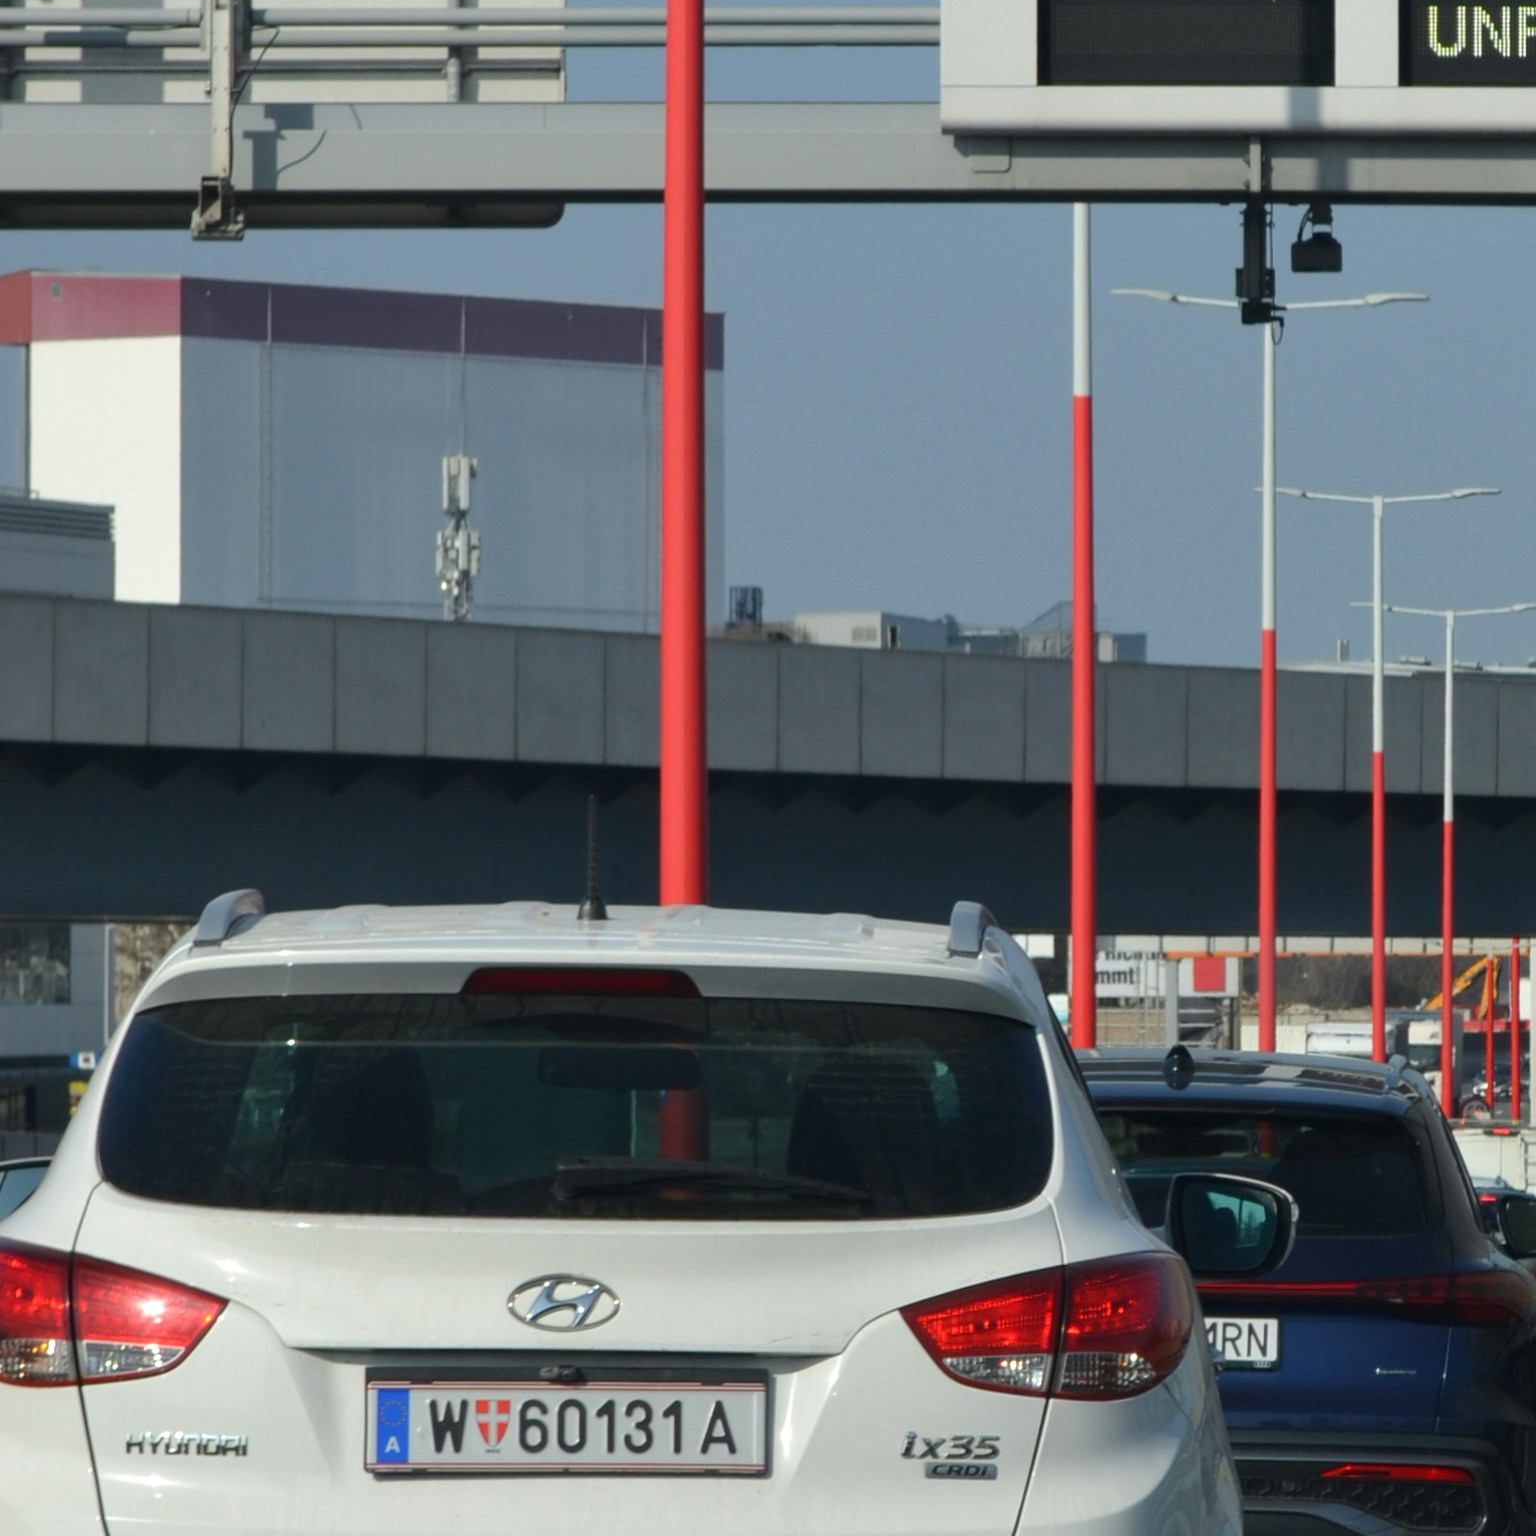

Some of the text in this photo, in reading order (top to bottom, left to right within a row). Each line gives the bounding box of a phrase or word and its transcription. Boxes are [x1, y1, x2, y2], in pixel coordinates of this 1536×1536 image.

[429, 1399, 737, 1454] W 60131 A
[125, 1431, 249, 1457] HYUNDAI
[384, 1435, 401, 1454] A
[901, 1430, 1001, 1460] ix35
[931, 1464, 988, 1478] CRDi
